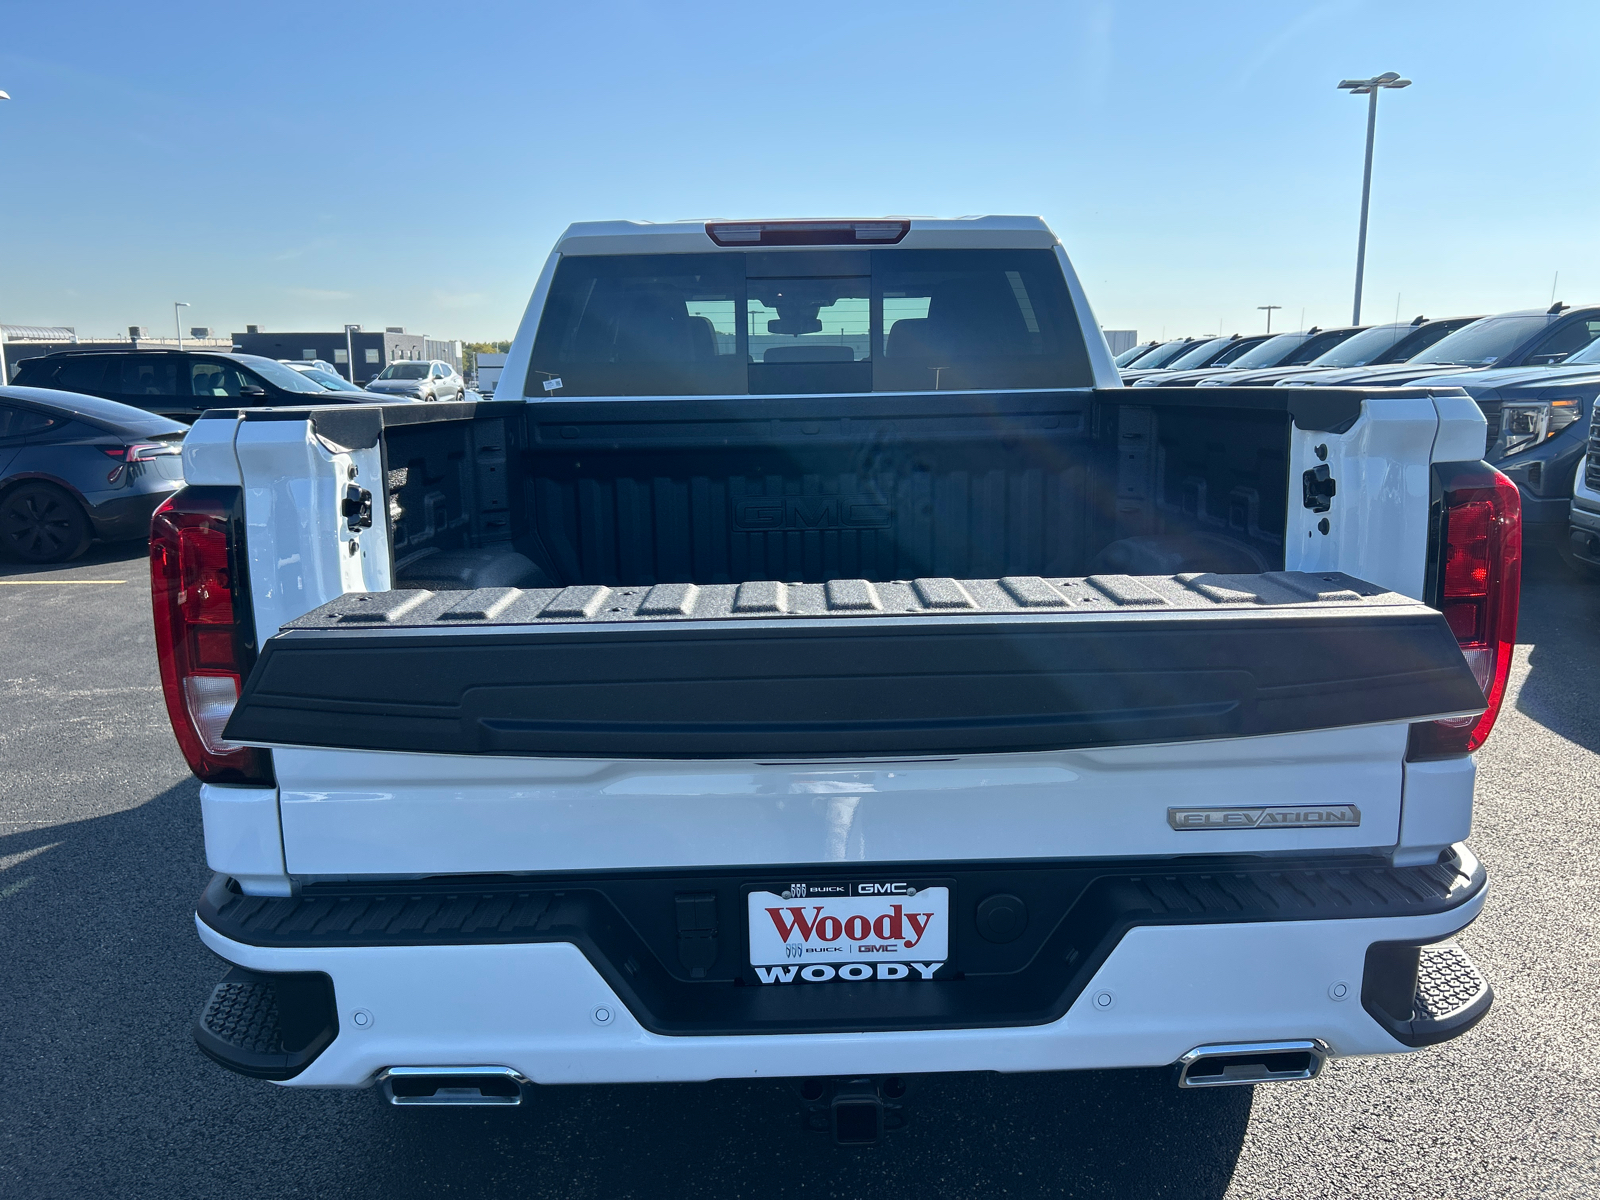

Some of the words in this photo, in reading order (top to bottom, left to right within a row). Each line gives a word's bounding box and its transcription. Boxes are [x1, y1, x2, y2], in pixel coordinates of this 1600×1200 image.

[735, 498, 889, 528] GMC
[1183, 811, 1346, 826] ELEVATION
[858, 883, 907, 894] GMC
[765, 904, 934, 948] Woody
[858, 944, 898, 953] GMC
[754, 963, 944, 984] WOODY
